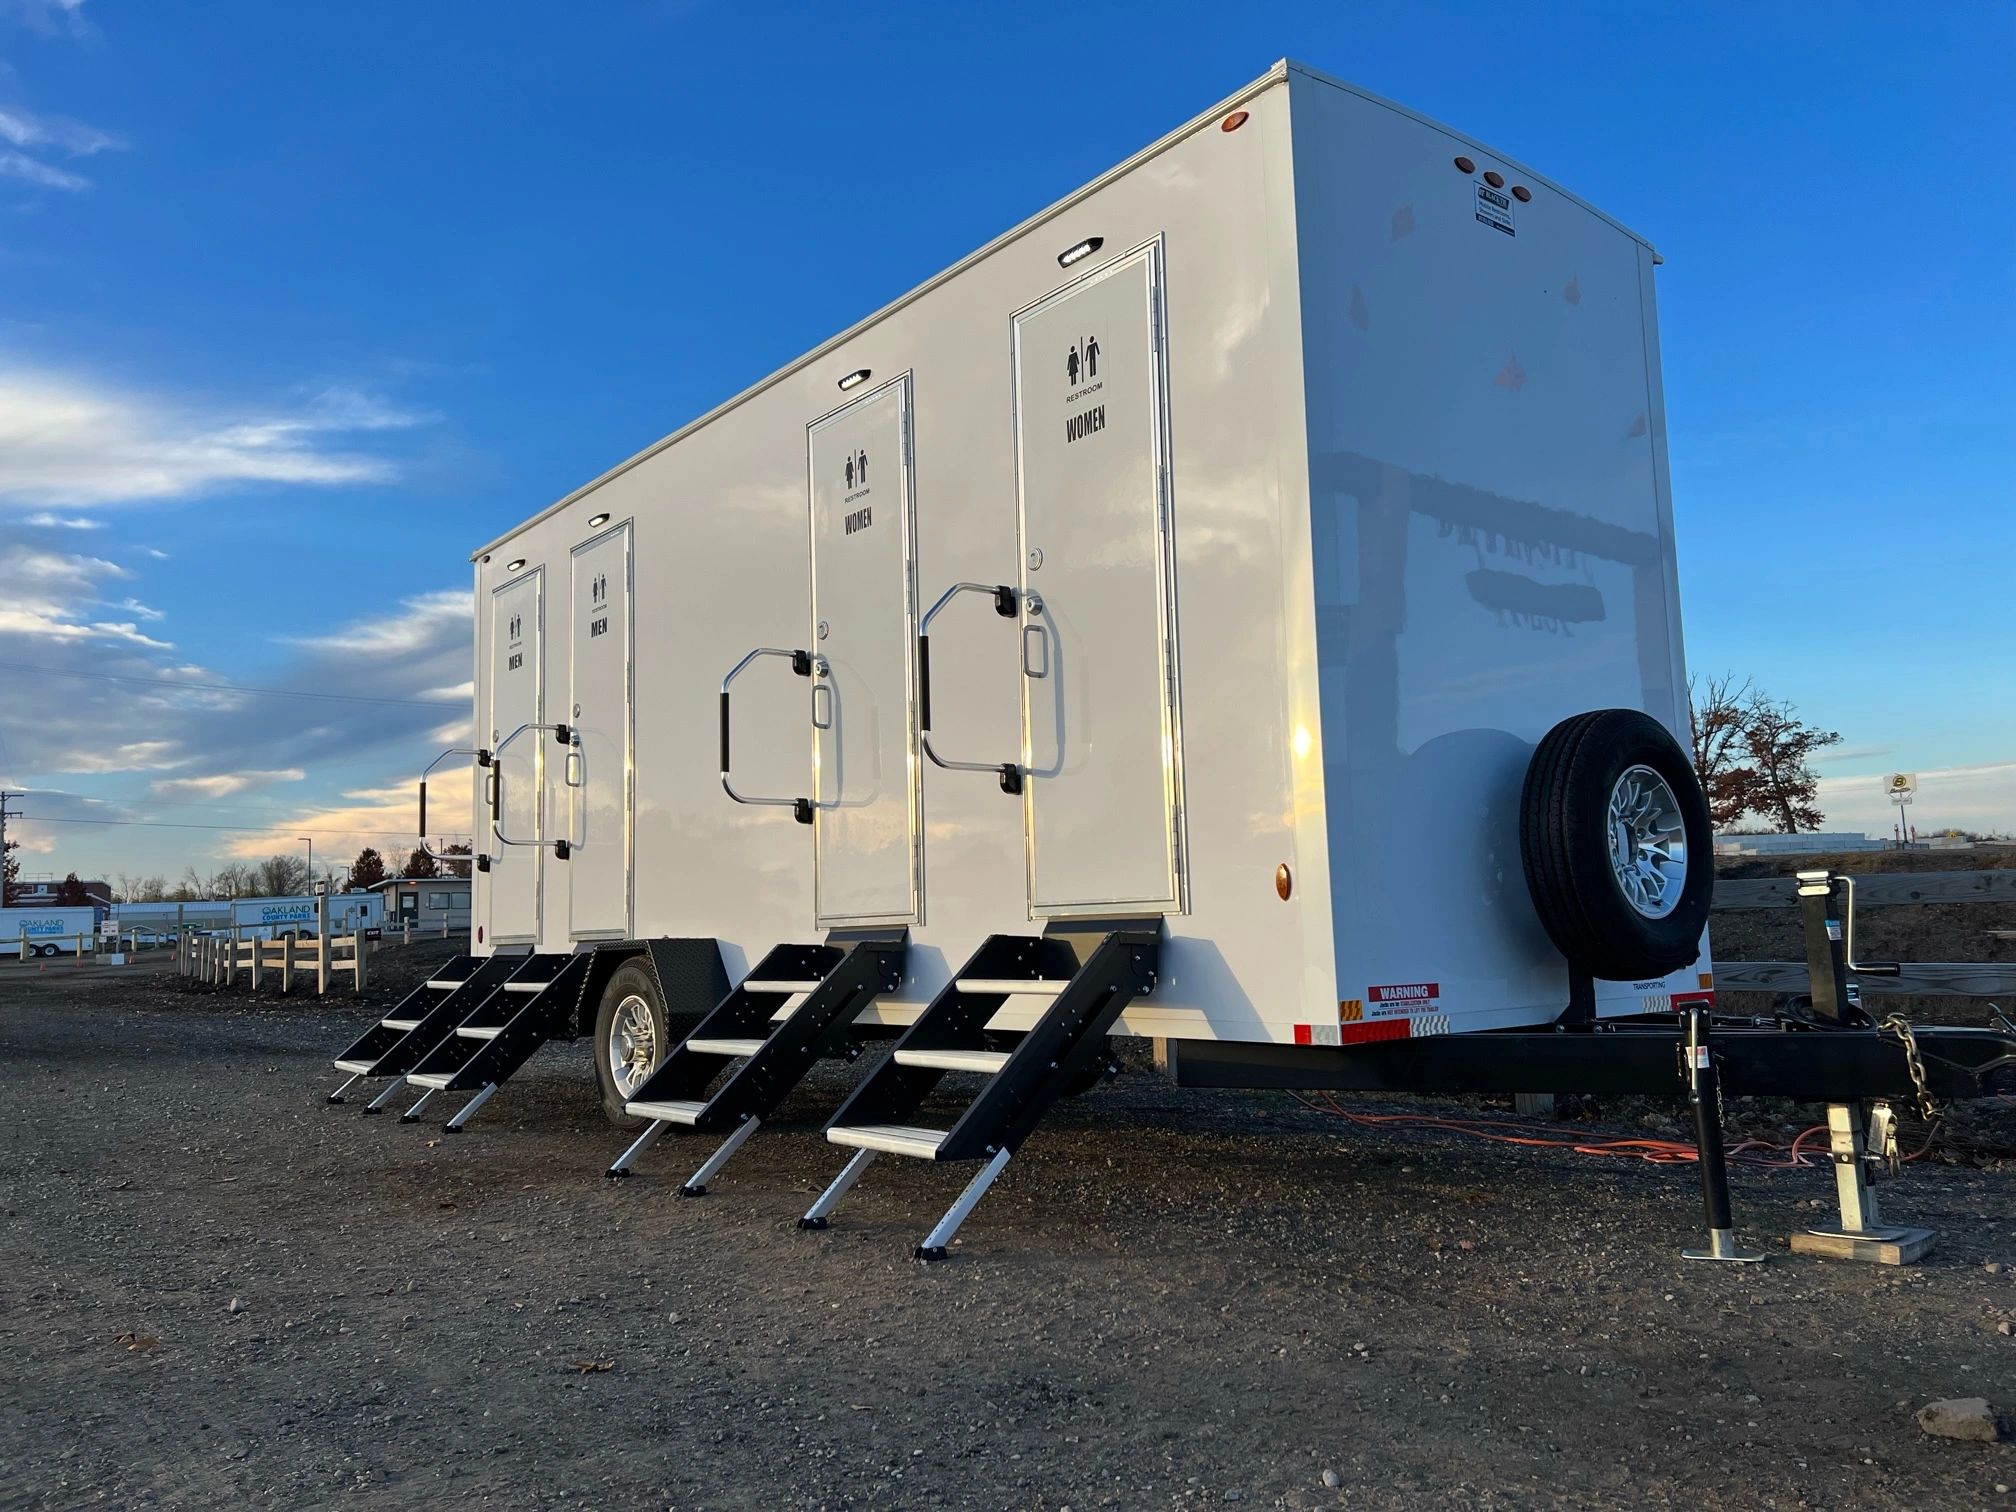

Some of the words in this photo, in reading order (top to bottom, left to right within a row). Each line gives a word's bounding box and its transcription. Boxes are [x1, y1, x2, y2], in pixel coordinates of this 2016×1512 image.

[1066, 381, 1103, 403] RESTROOM
[1066, 404, 1105, 443] WOMEN
[844, 488, 870, 503] RESTROOM
[845, 505, 872, 535] WOMEN
[591, 617, 608, 638] MEN
[508, 652, 523, 671] MEN
[262, 904, 311, 915] OAKLAND
[19, 919, 64, 928] OAKLAND
[1380, 985, 1429, 999] WARNING
[1632, 981, 1666, 991] TRANSPORTING
